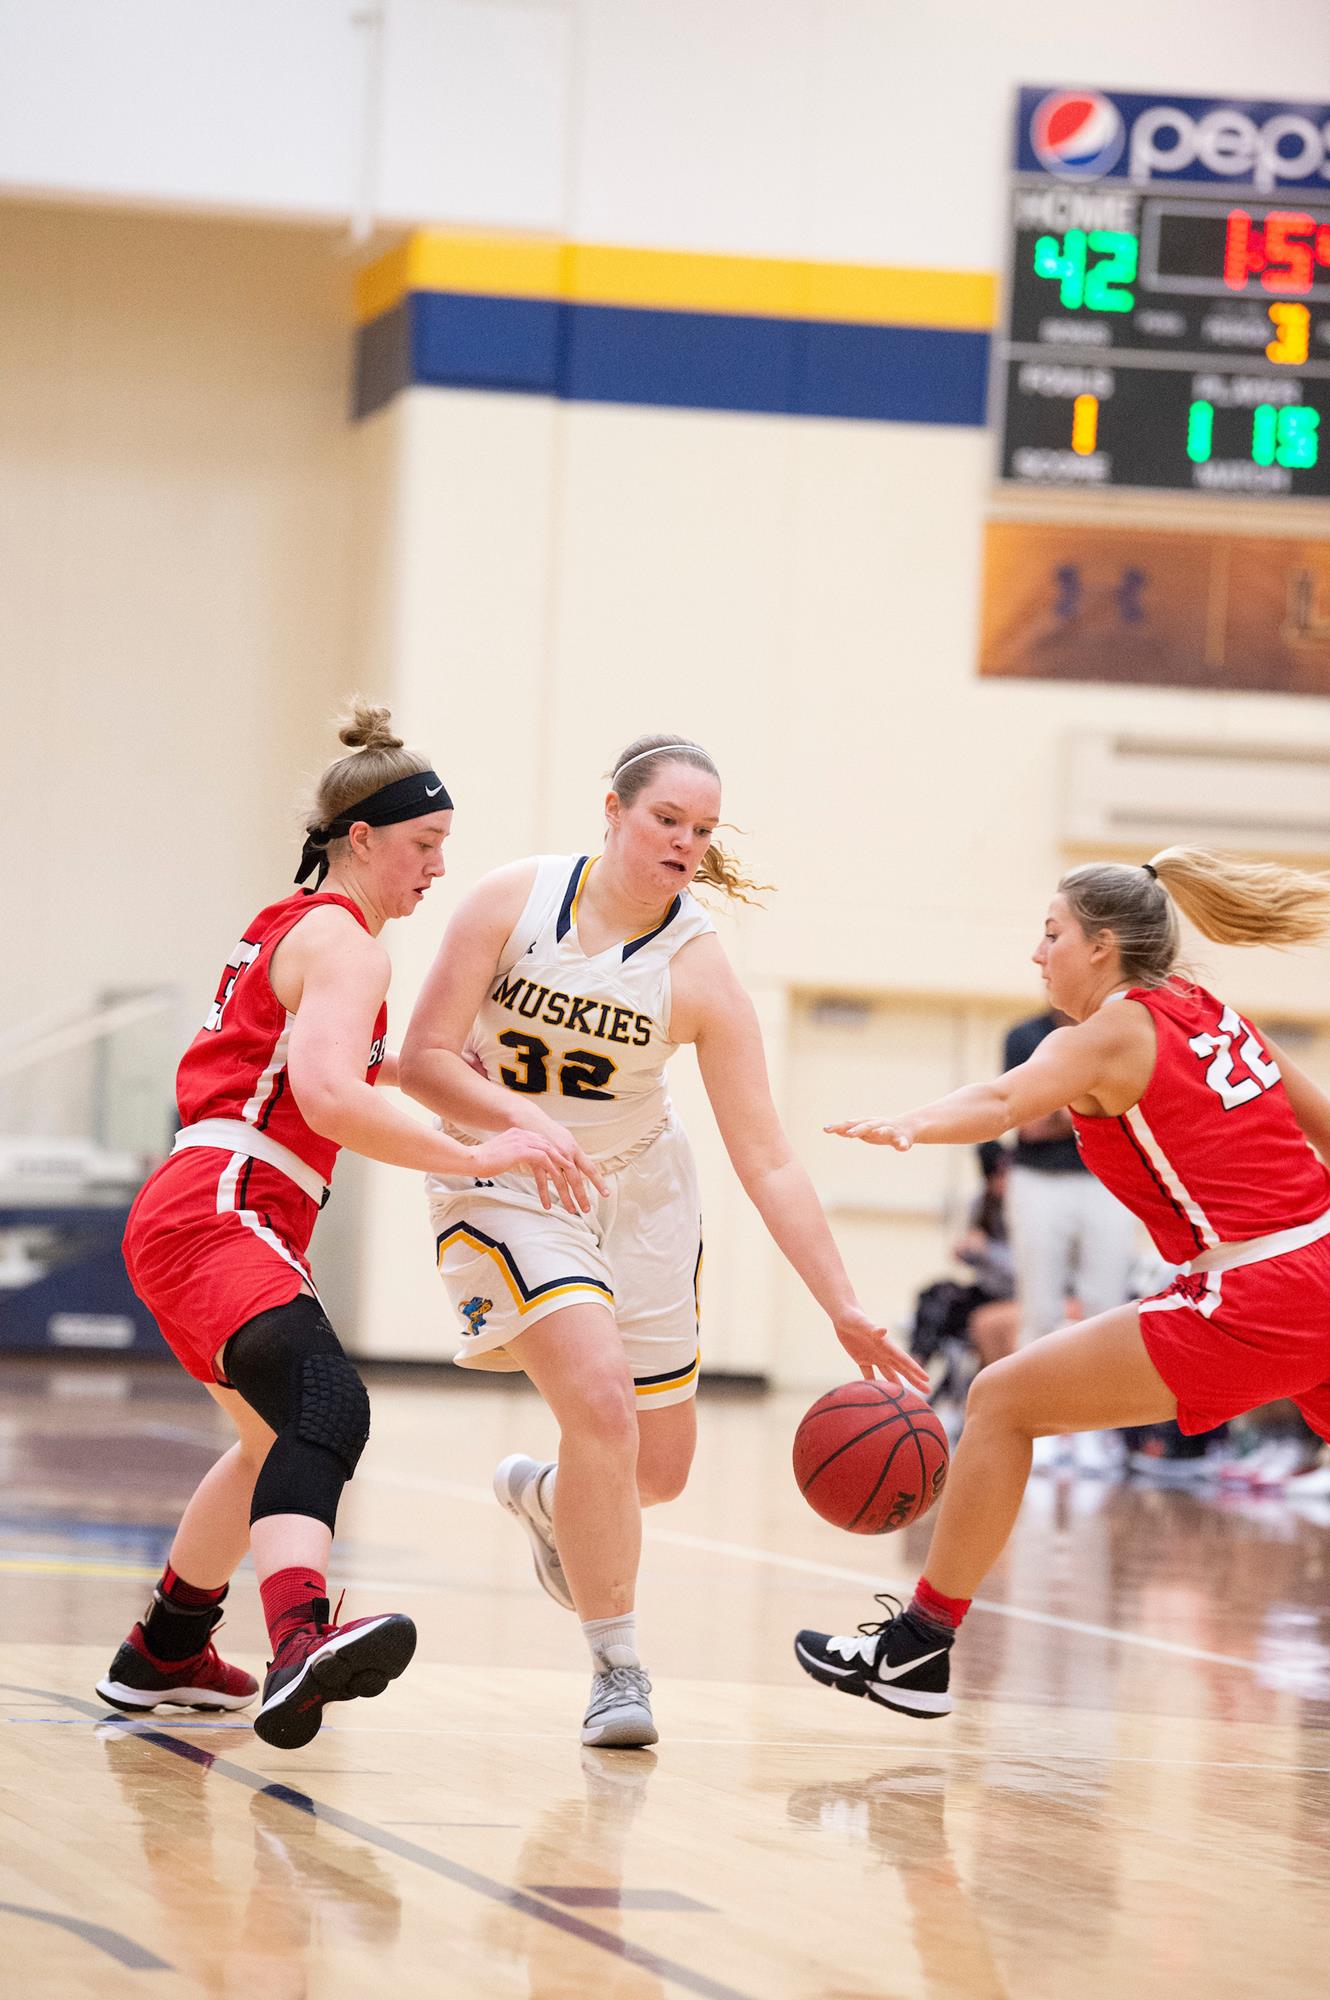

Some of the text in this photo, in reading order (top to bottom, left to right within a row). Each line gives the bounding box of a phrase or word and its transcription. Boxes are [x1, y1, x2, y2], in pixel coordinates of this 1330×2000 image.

[1034, 228, 1138, 312] 42
[1265, 302, 1311, 365] 3
[491, 974, 653, 1046] MUSKIES
[497, 1027, 619, 1101] 32
[1187, 1004, 1282, 1112] 22
